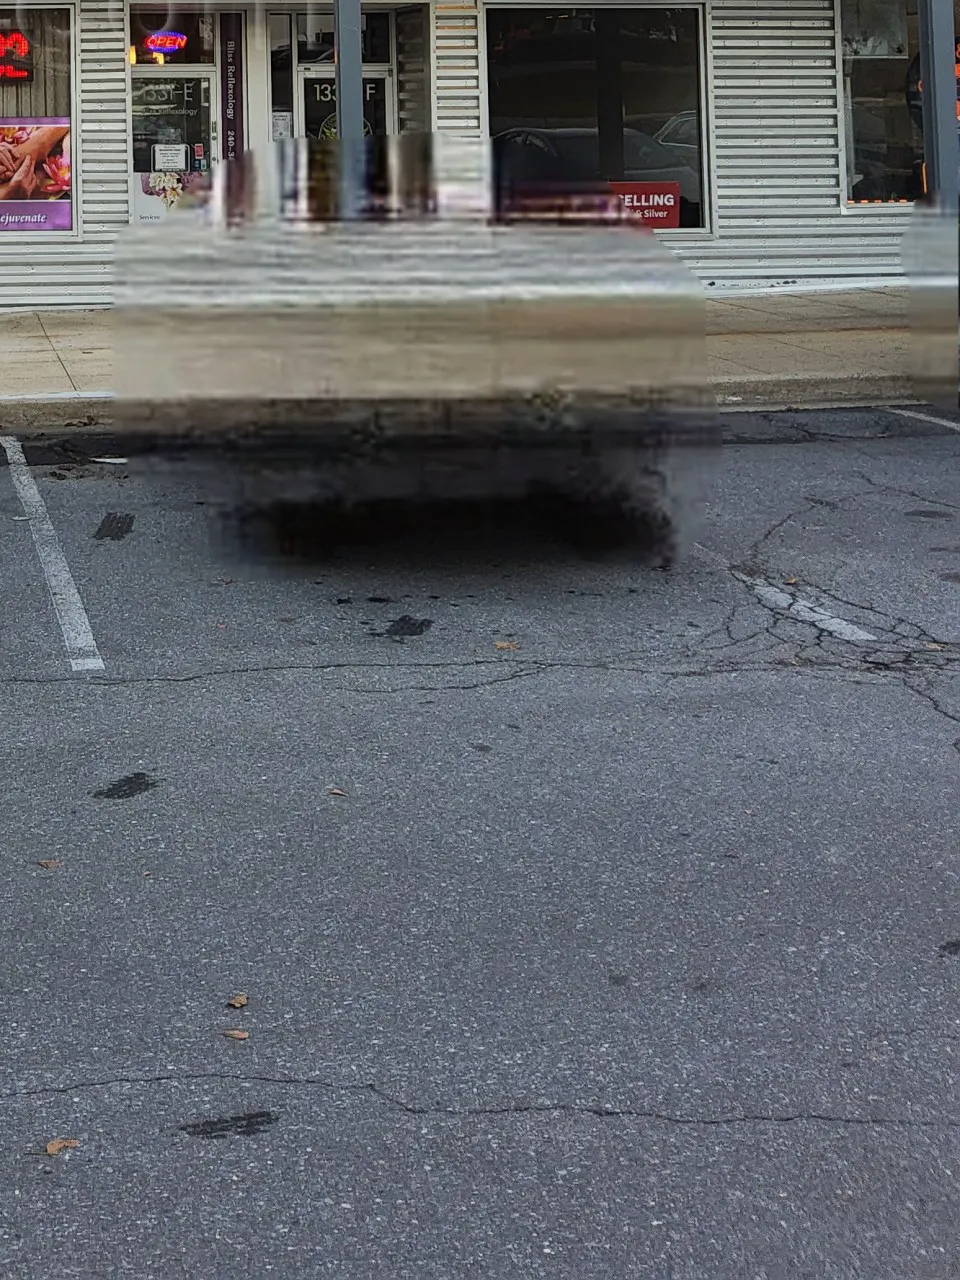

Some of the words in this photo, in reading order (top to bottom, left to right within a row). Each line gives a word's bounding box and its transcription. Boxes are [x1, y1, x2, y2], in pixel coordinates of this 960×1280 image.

[146, 35, 187, 48] OPEN
[227, 41, 235, 63] Bliss
[226, 66, 236, 120] Reflexology
[644, 209, 668, 218] Silver
